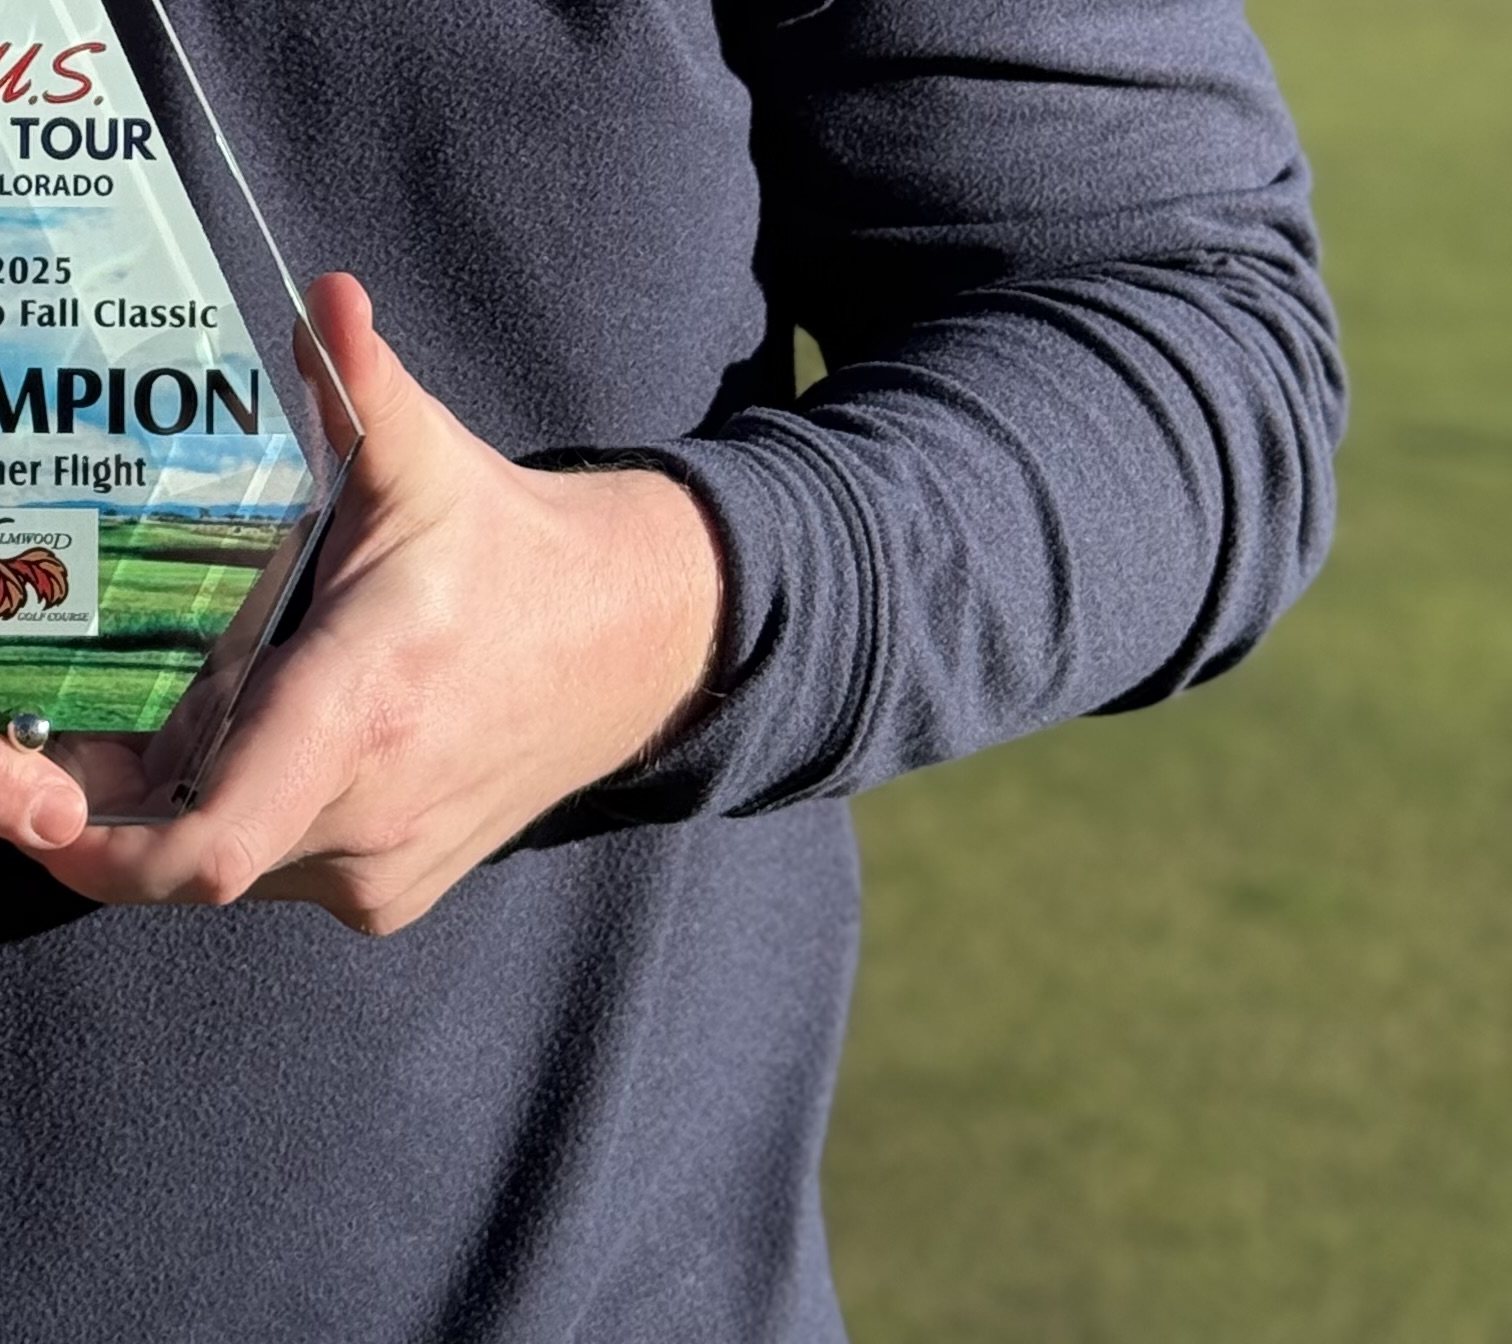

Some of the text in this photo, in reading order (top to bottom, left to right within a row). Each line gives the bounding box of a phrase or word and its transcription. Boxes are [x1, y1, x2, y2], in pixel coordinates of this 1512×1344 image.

[11, 117, 156, 161] TOUR
[20, 298, 80, 328] Fall
[94, 298, 218, 329] Classic
[53, 455, 146, 493] Flight
